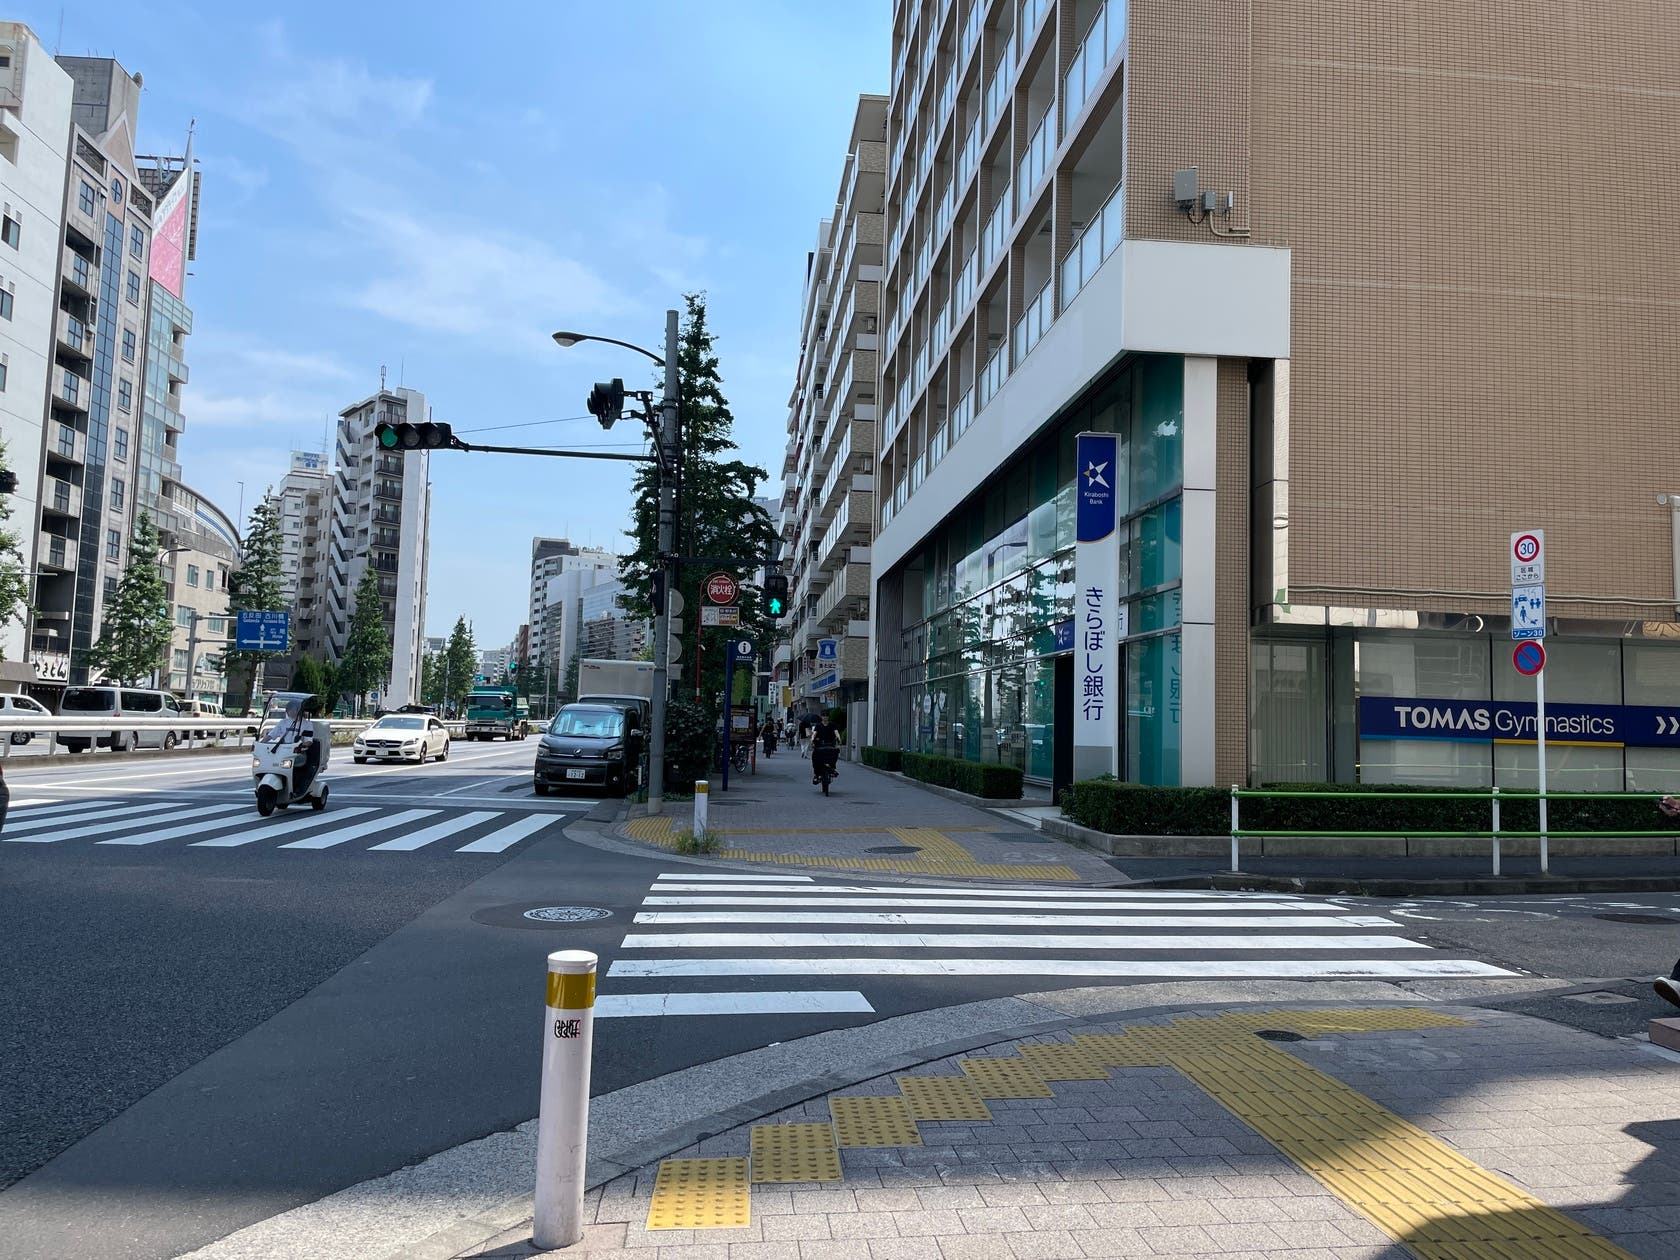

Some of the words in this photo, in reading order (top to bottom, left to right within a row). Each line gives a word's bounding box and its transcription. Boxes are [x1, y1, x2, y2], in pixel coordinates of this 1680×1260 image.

[1519, 542, 1534, 555] 30
[1516, 573, 1539, 581] ここから
[711, 585, 732, 595] 消火栓
[1083, 586, 1105, 721] きらぼし銀行
[1394, 706, 1490, 731] TOMAS
[1495, 709, 1615, 736] Gymnastics
